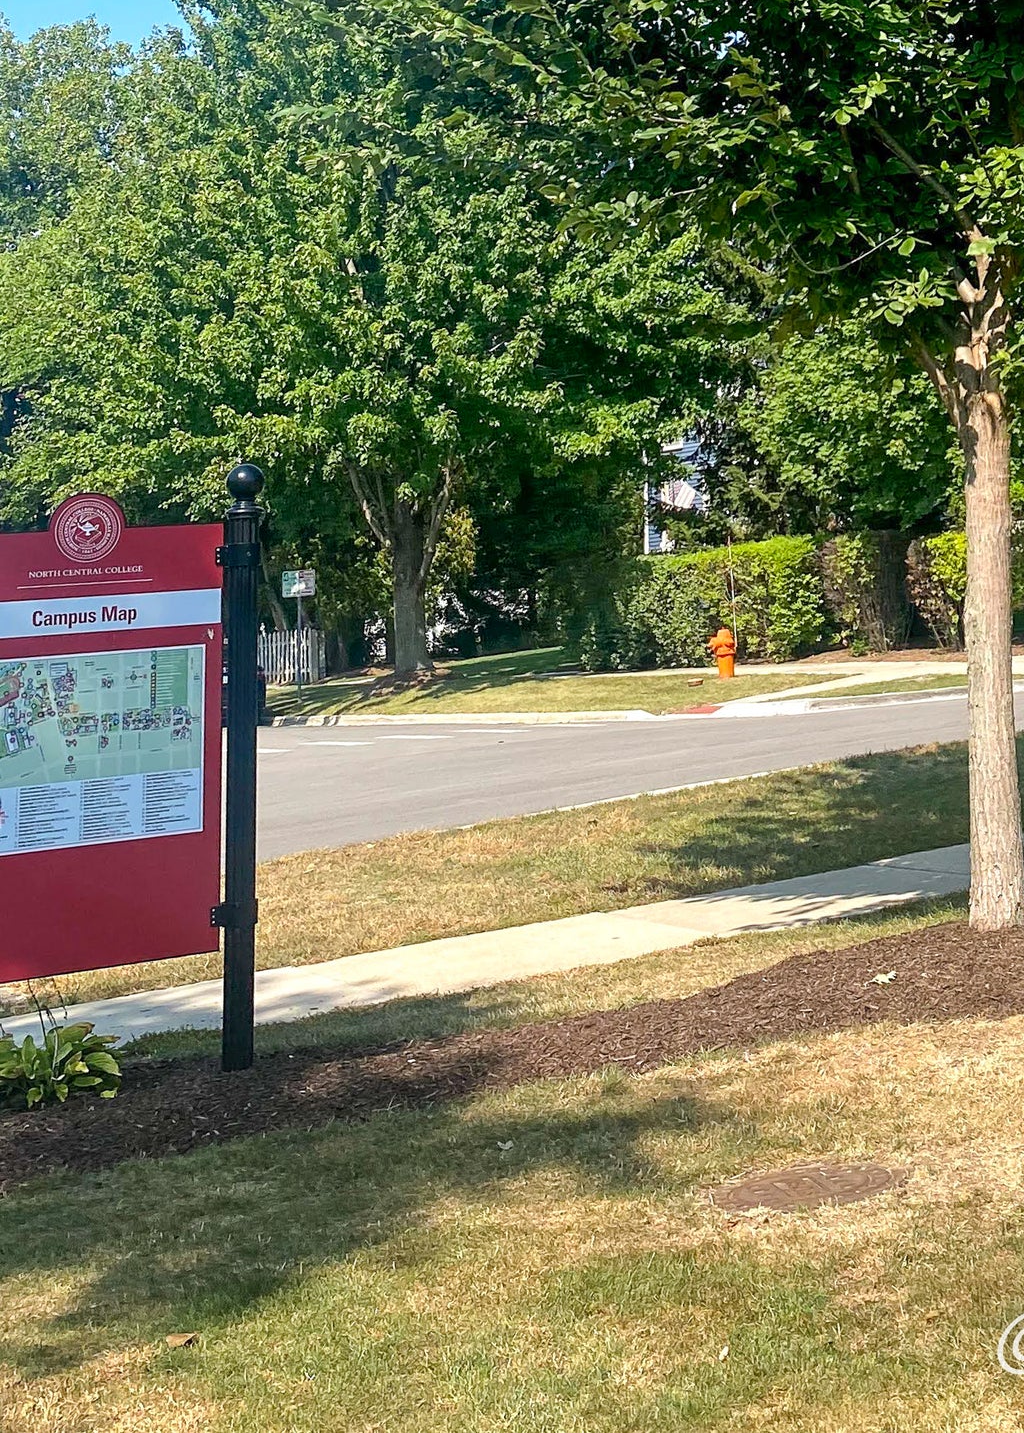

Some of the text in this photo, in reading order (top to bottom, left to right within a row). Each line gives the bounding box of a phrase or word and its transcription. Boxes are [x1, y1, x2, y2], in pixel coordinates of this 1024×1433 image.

[28, 565, 143, 579] NORTH CENTRAL COLLEGE
[32, 606, 137, 628] Campus Map
